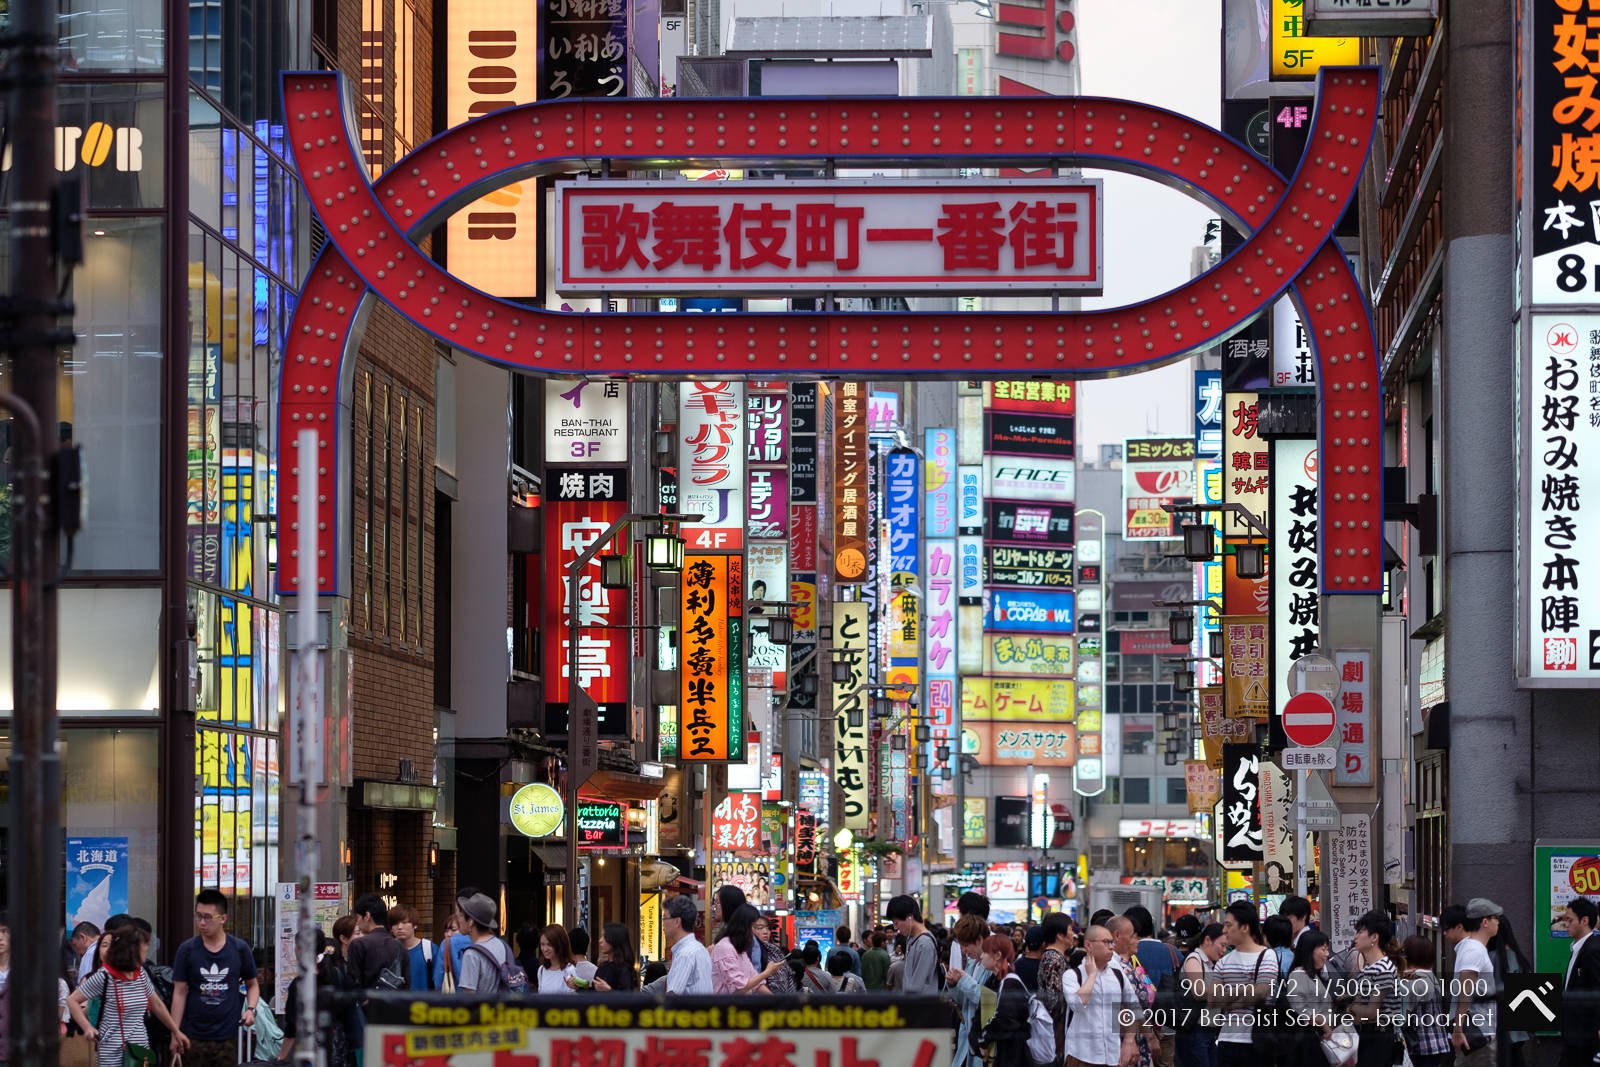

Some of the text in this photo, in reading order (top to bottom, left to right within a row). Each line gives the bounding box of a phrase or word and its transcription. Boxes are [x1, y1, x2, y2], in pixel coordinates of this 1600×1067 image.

[667, 21, 681, 31] 5F
[1283, 50, 1314, 69] 5F
[1277, 106, 1307, 128] 4F
[582, 201, 1077, 272] 歌舞伎町一番街
[1228, 339, 1269, 358] 酒場
[1277, 372, 1291, 384] 3F
[604, 382, 618, 398] 店
[994, 381, 1071, 402] 全店営業中
[554, 428, 619, 437] RESTAURANT
[561, 419, 612, 427] BAN-THAI
[765, 397, 782, 461] レンタル
[571, 442, 600, 457] 3F
[842, 382, 858, 536] 個室ダイニング居酒屋
[560, 472, 614, 498] 焼肉
[995, 468, 1073, 483] FACE
[751, 471, 772, 519] エデン
[891, 455, 915, 552] カラオケ
[963, 475, 978, 518] SEGA
[1541, 356, 1579, 633] お好み焼き本陣
[696, 530, 727, 548] 4F
[891, 555, 915, 571] 747
[963, 544, 978, 588] SEGA
[728, 561, 740, 609] 炭火串焼
[561, 517, 611, 689] 安楽亭
[930, 546, 952, 669] カラオケ
[902, 594, 917, 641] 麻雀
[995, 636, 1071, 663] まんが喫茶
[1342, 660, 1364, 774] 劇場通り
[998, 731, 1068, 747] メンズサウナ
[1286, 753, 1332, 766] 自転車を除く
[577, 804, 619, 817] rattoria
[585, 830, 605, 840] Bar
[1138, 821, 1188, 837] コーヒー
[77, 850, 118, 863] 北海道
[1346, 826, 1360, 926] 防犯カメラ作動中
[546, 1008, 580, 1024] on
[587, 1005, 632, 1025] the
[639, 1005, 720, 1029] street
[728, 1005, 750, 1028] is
[758, 1004, 906, 1031] prohibited.
